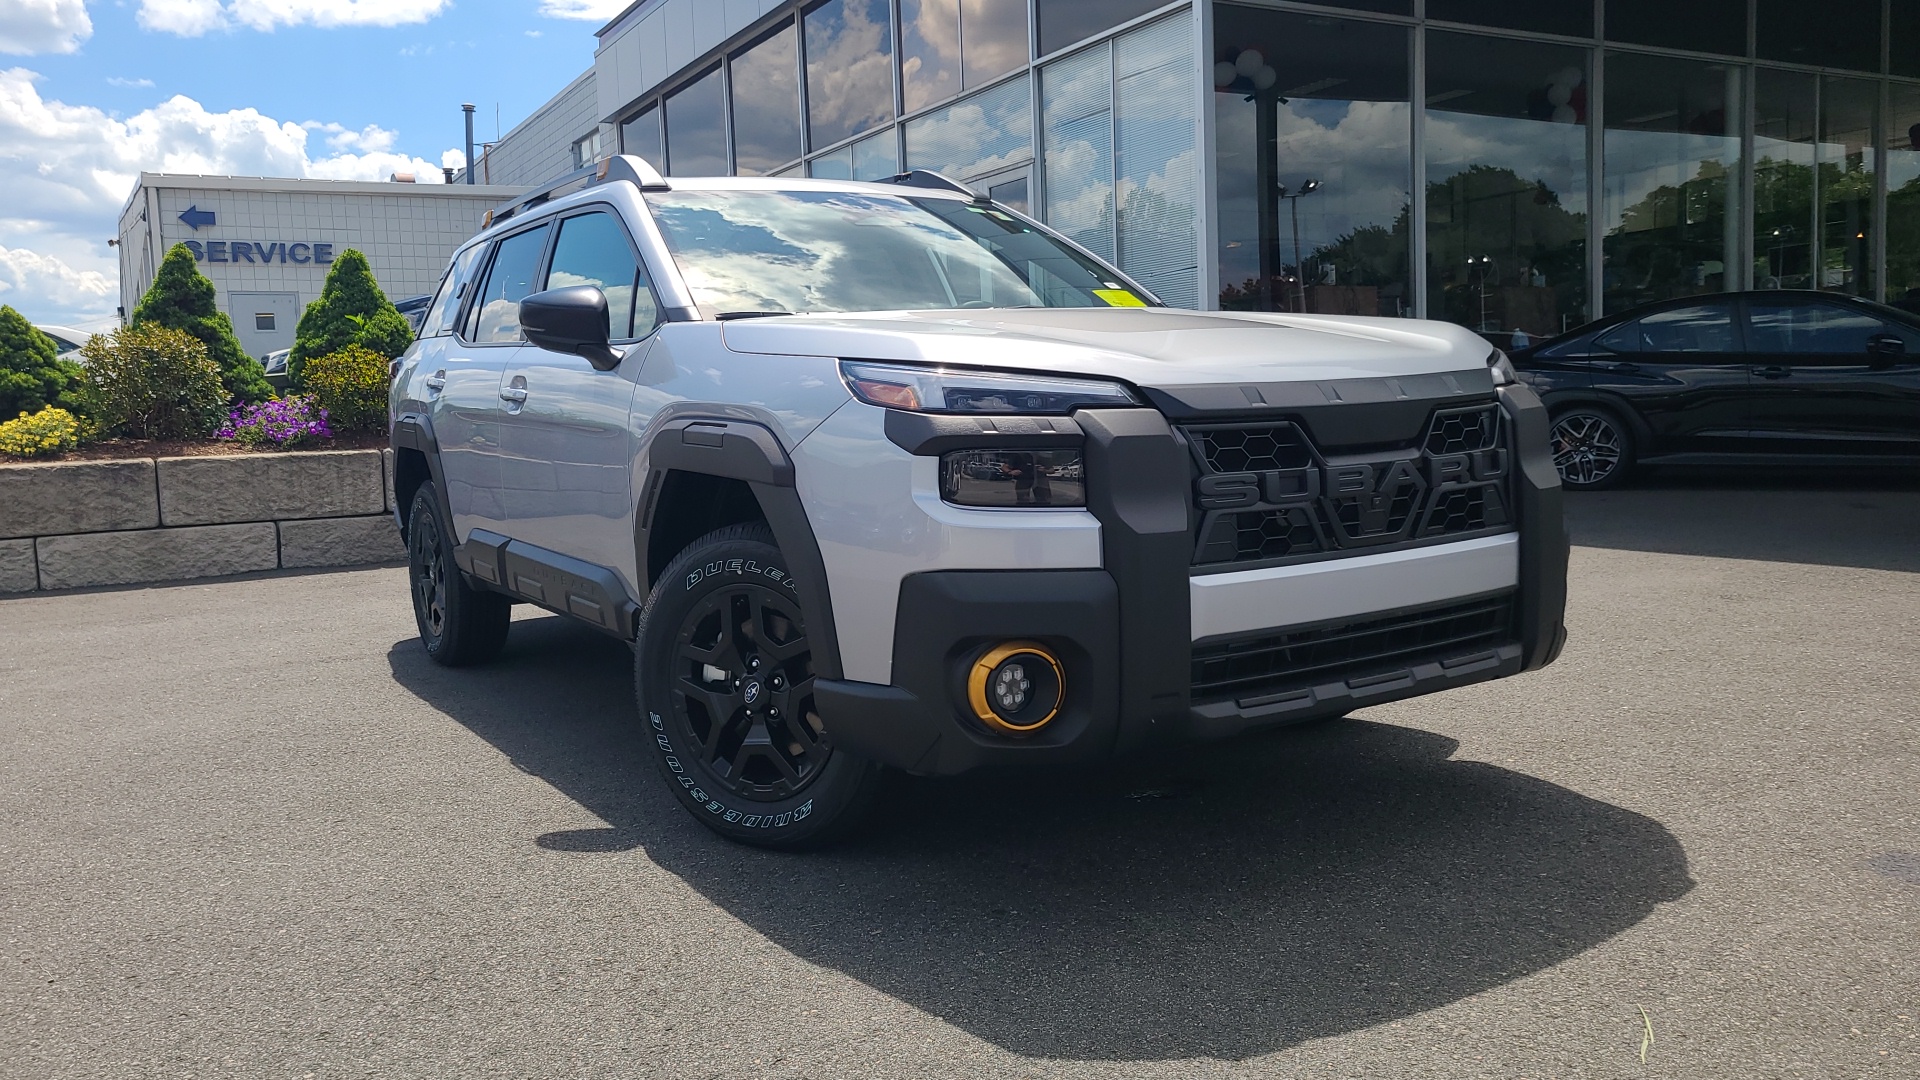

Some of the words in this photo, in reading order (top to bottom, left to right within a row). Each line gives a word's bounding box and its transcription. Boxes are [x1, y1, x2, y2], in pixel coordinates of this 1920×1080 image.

[184, 240, 335, 264] SERVICE
[1197, 448, 1507, 509] SUBARU
[649, 711, 813, 829] BRIDGESTONE
